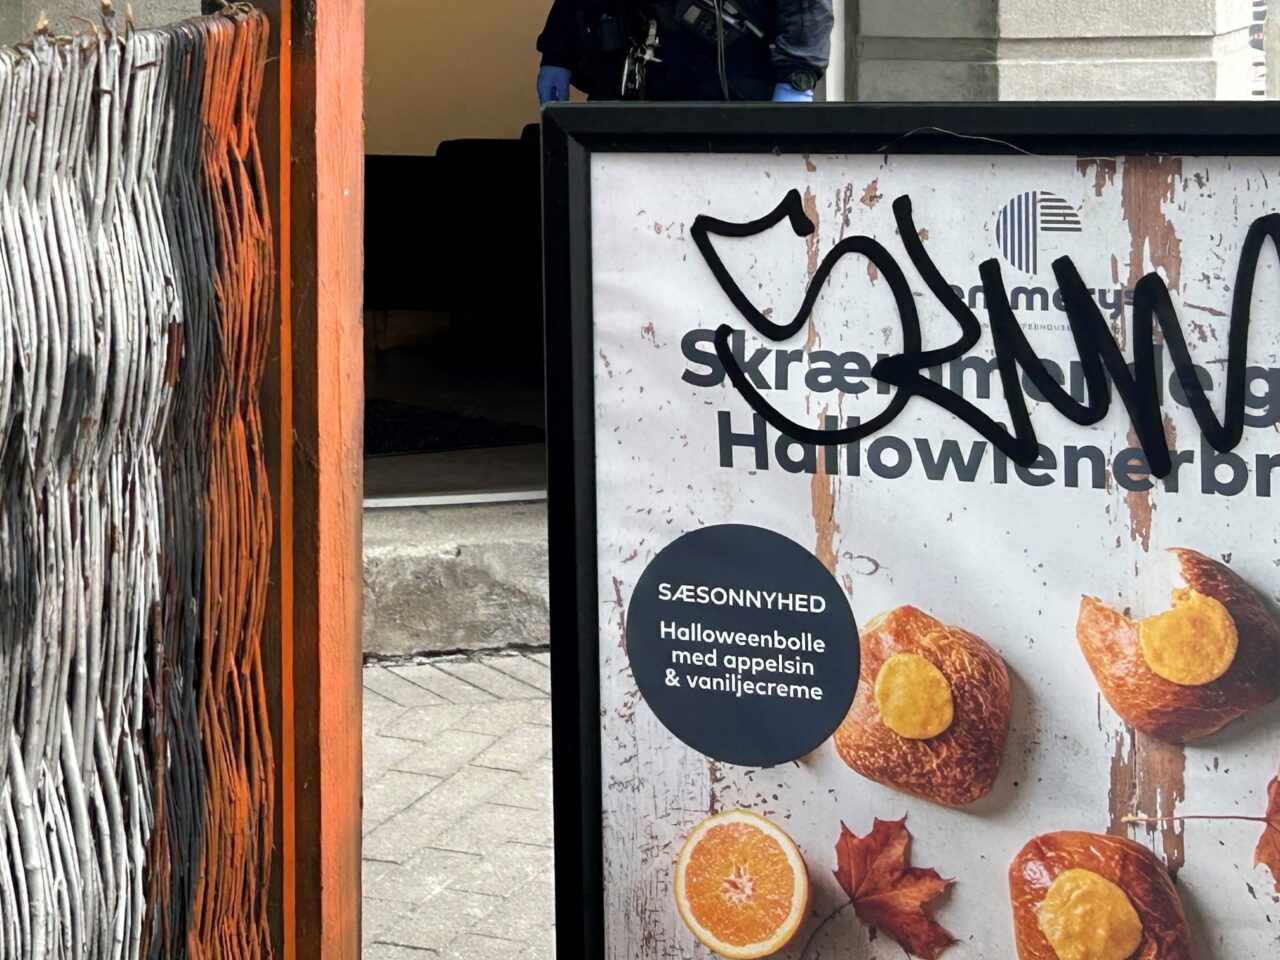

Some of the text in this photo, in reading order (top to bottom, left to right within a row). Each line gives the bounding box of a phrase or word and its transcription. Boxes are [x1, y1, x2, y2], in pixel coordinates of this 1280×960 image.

[658, 582, 826, 614] SÆSONNYHED
[660, 620, 826, 653] Halloweenbolle
[671, 648, 814, 676] med appelsin
[664, 668, 823, 701] & vaniljecreme
